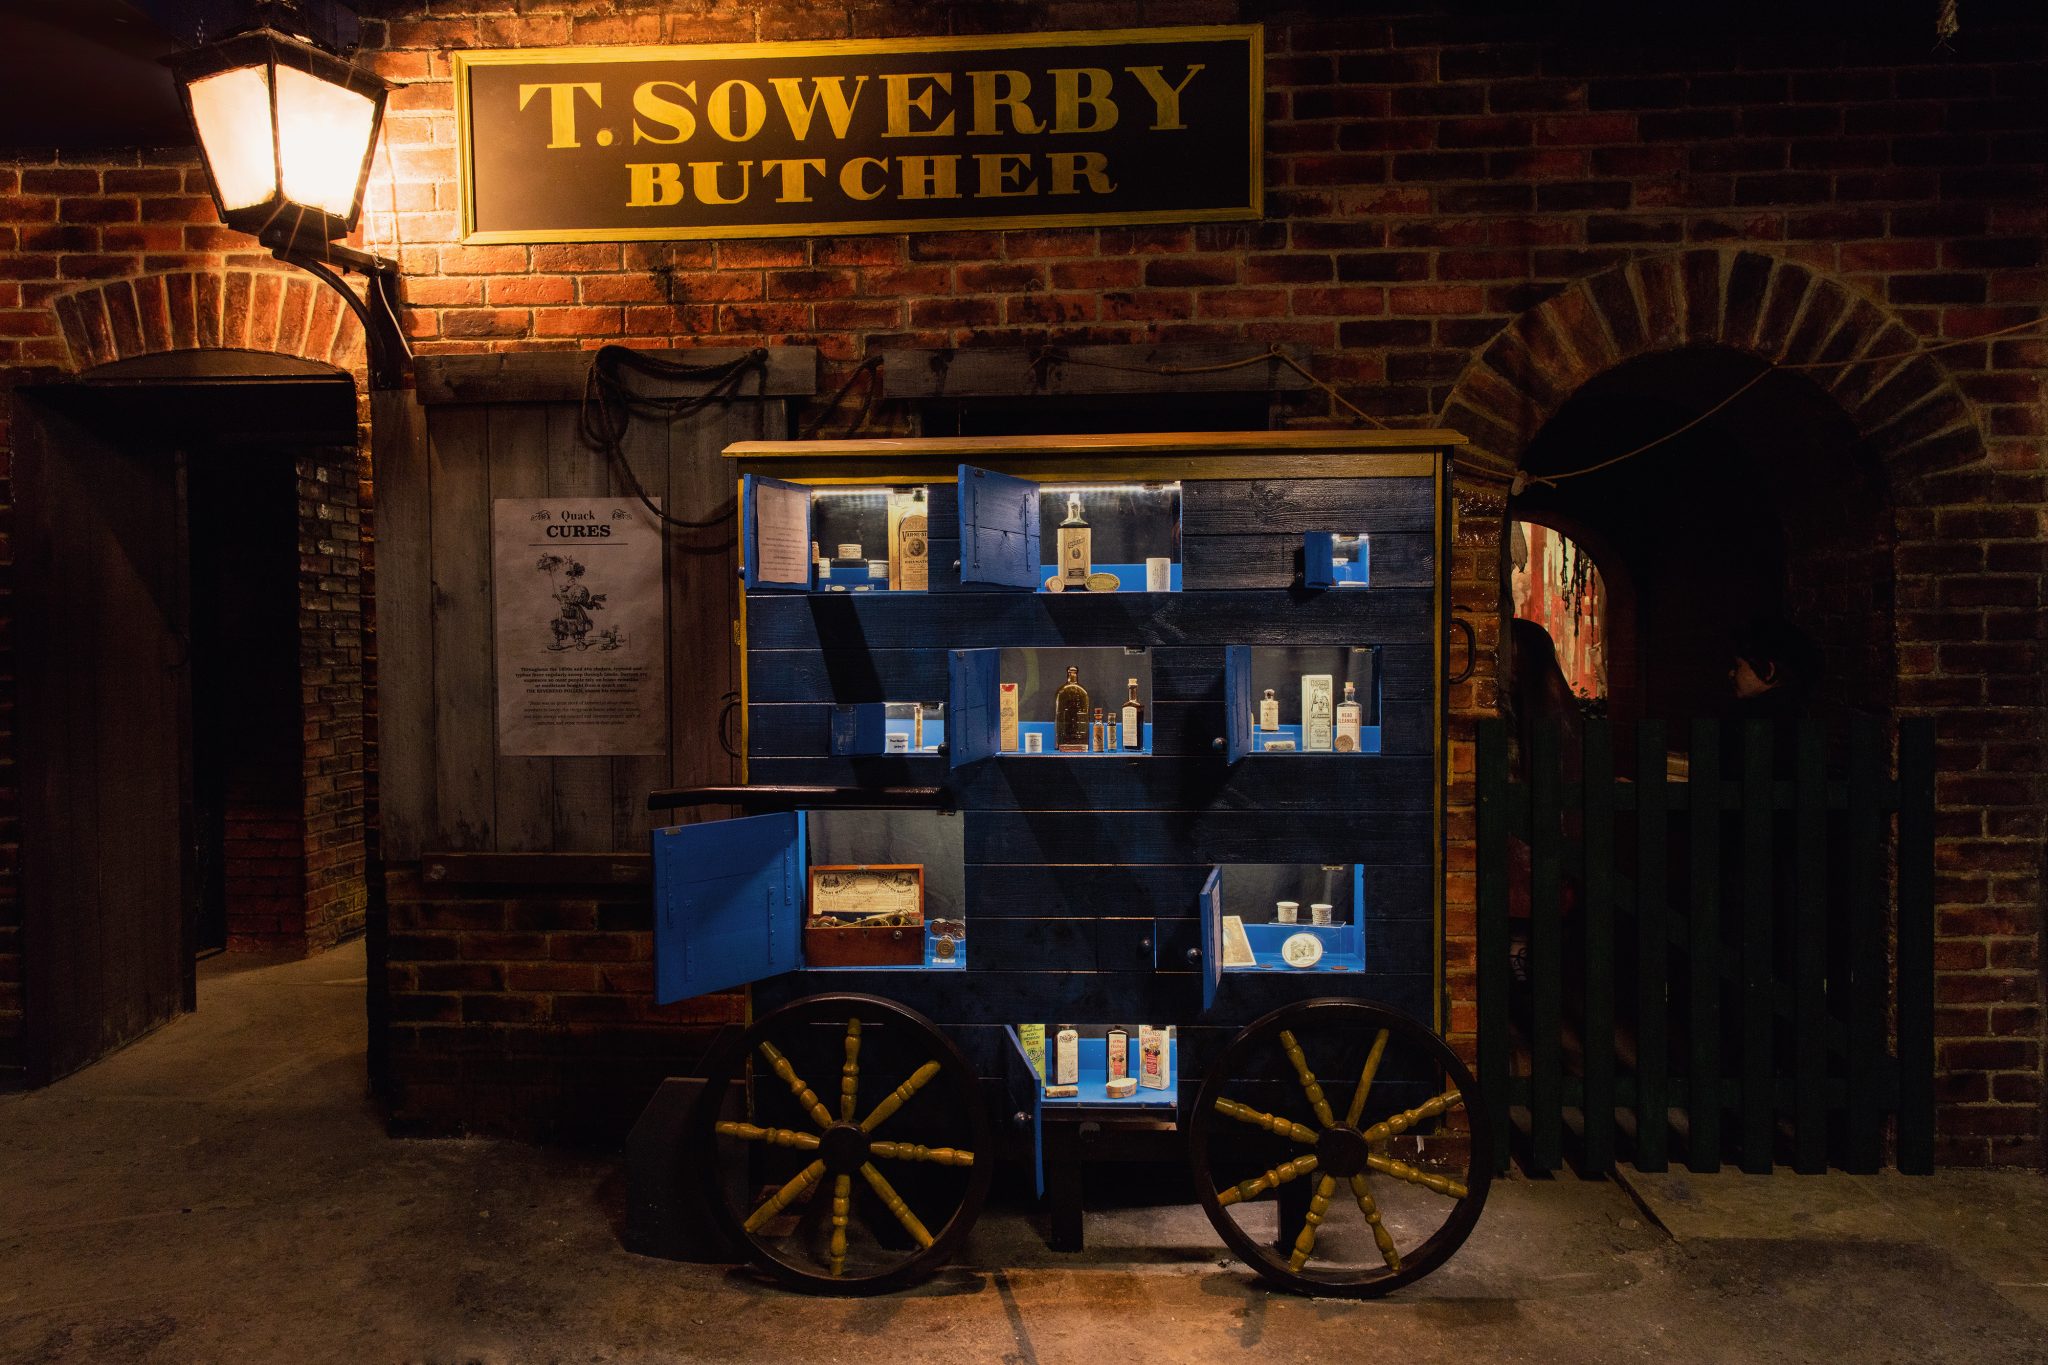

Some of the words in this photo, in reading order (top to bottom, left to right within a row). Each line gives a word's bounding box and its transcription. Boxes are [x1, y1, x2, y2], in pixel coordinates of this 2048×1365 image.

[632, 64, 1206, 145] SOWERBY
[625, 152, 1118, 208] BUTCHER
[546, 524, 611, 538] CURES
[561, 510, 596, 522] Quack
